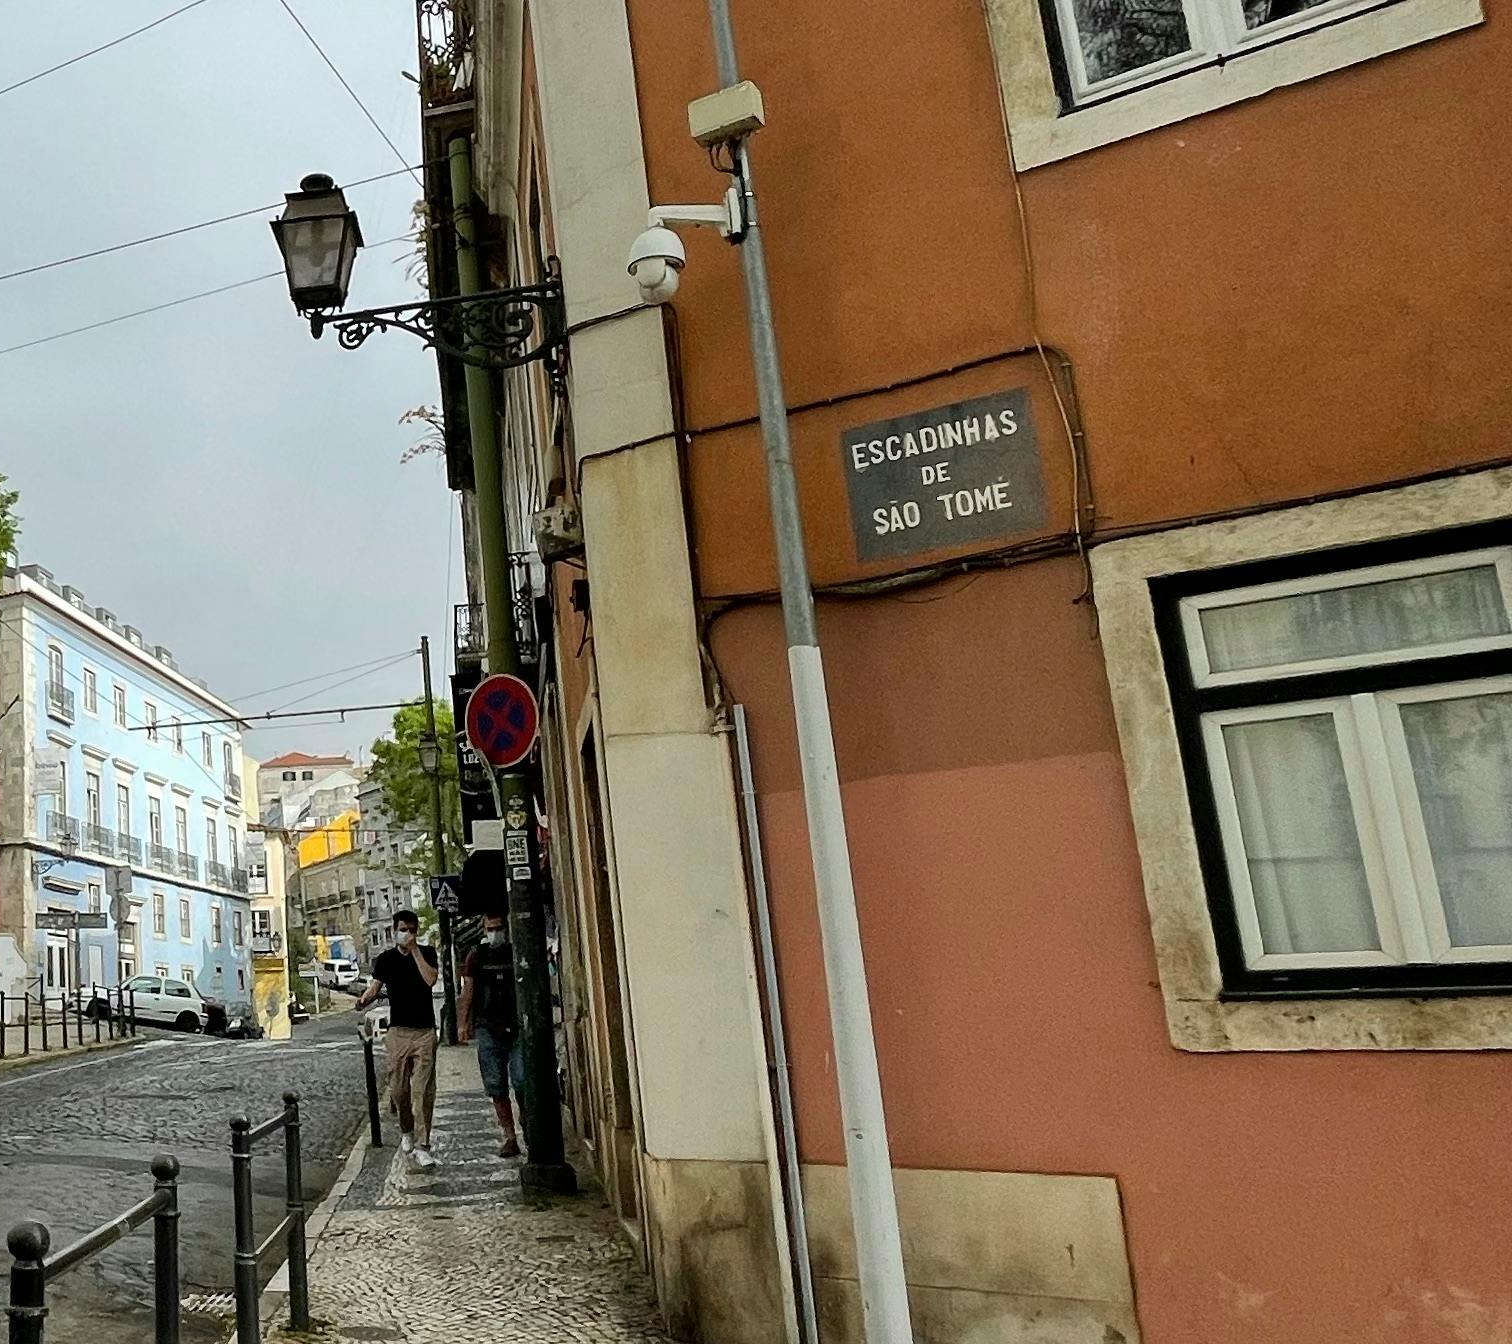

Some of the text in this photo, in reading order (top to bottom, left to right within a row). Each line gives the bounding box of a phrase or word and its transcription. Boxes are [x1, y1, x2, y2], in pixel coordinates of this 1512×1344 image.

[851, 409, 1018, 471] ESCADINHAS
[921, 461, 952, 486] DE
[872, 476, 1013, 536] SÃO TOMÉ
